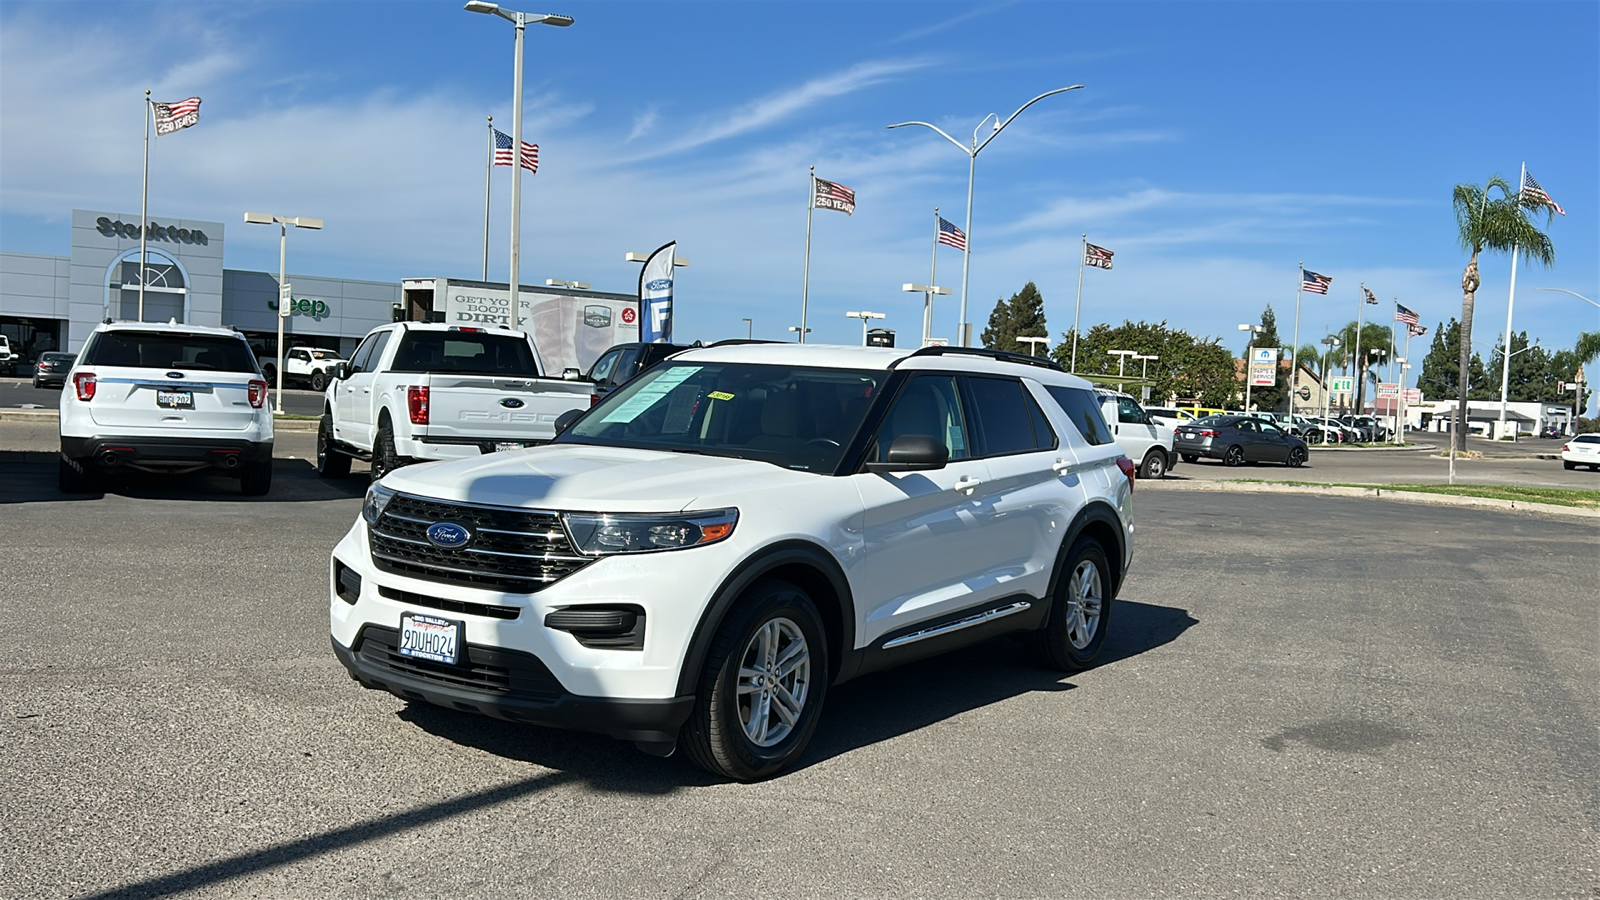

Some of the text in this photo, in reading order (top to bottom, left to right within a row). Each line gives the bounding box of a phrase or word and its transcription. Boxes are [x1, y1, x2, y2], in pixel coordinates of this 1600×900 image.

[158, 114, 198, 133] 250 YEARS
[816, 197, 832, 207] 250
[96, 217, 208, 246] Stockton
[650, 280, 670, 290] Ford
[455, 295, 530, 308] GET YOR
[467, 304, 511, 315] BOOT
[456, 311, 528, 326] DIRTY
[434, 526, 459, 542] Ford
[425, 617, 446, 625] VALLEY
[403, 629, 453, 656] 9DUH024
